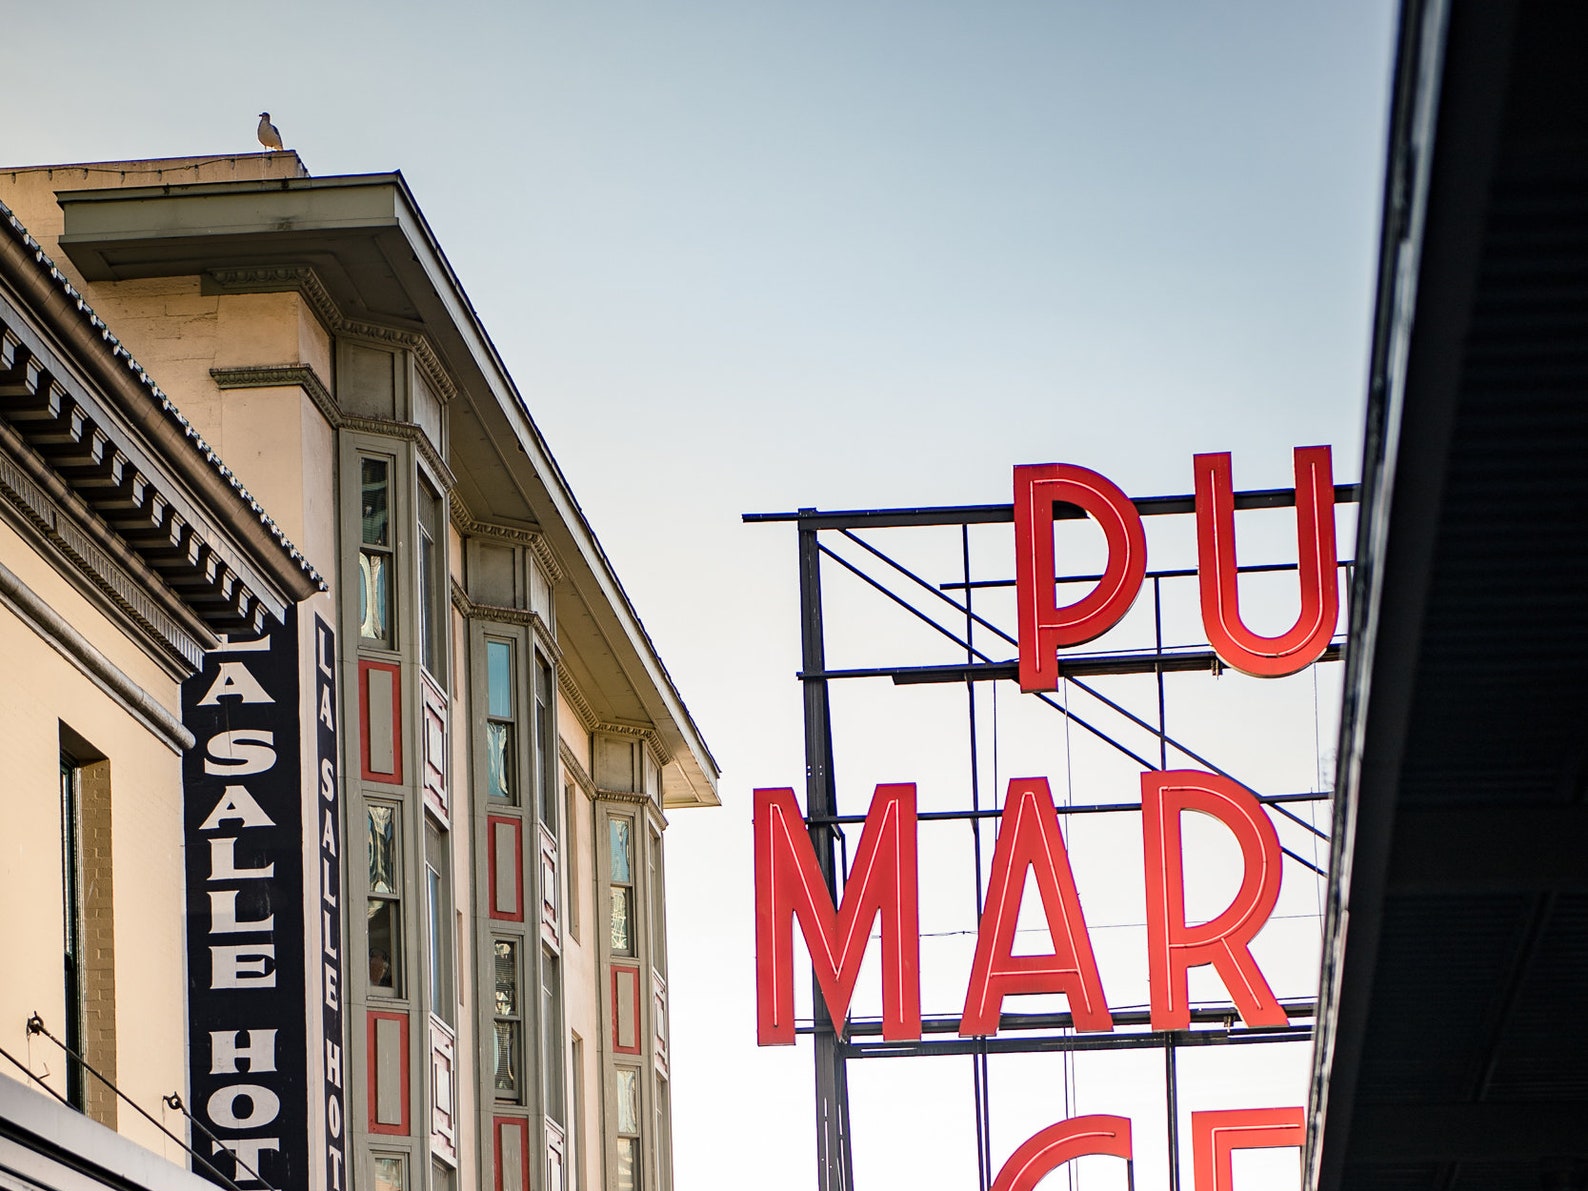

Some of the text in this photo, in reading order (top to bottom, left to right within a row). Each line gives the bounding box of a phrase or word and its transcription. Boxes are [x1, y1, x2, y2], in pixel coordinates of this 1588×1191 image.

[318, 626, 335, 732] LA
[1013, 445, 1340, 694] PU
[198, 729, 278, 990] SALLE
[319, 757, 339, 1012] SALLE
[752, 768, 1292, 1047] MAR
